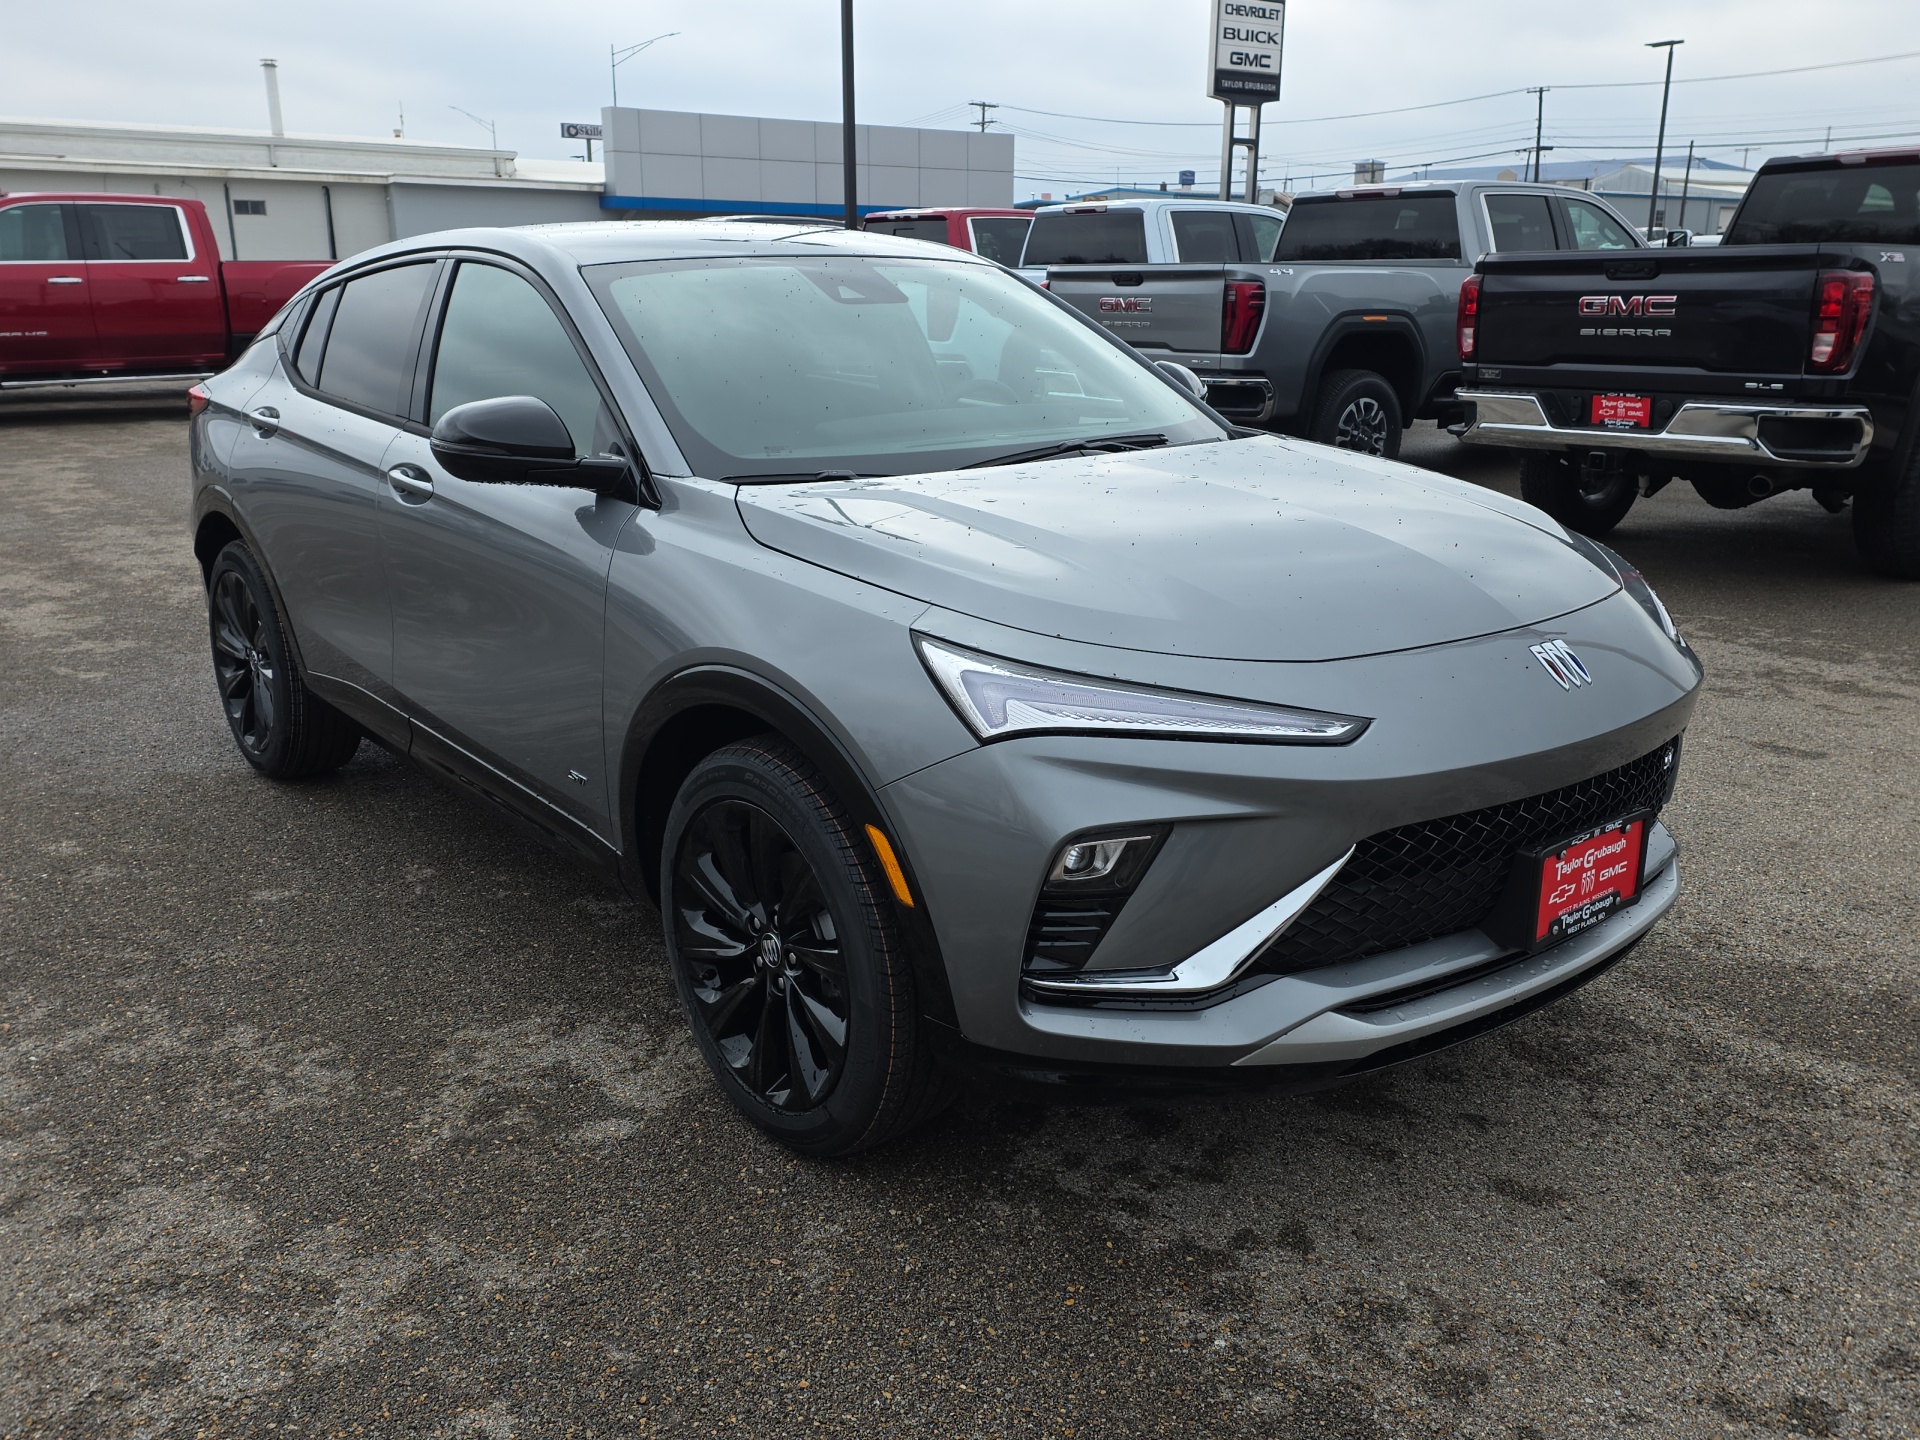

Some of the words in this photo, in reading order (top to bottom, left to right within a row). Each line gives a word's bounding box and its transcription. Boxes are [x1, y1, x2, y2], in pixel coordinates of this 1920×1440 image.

[1225, 3, 1281, 20] CHEVROLET
[1223, 27, 1279, 45] BUICK
[1230, 51, 1271, 68] GMC
[1221, 79, 1243, 89] TAYLOR
[1244, 81, 1276, 92] GRUBAUGH
[1100, 297, 1152, 314] GMC
[1579, 295, 1677, 316] GMC
[1580, 328, 1672, 337] SIERRA
[1744, 382, 1784, 390] SLE
[1605, 820, 1623, 833] GMC
[1556, 857, 1583, 881] Taylor
[1584, 838, 1626, 868] Grubaugh
[1600, 861, 1628, 881] GMC
[1560, 910, 1583, 930] Taylor
[1582, 894, 1614, 920] Grubaugh
[1567, 923, 1581, 935] WEST
